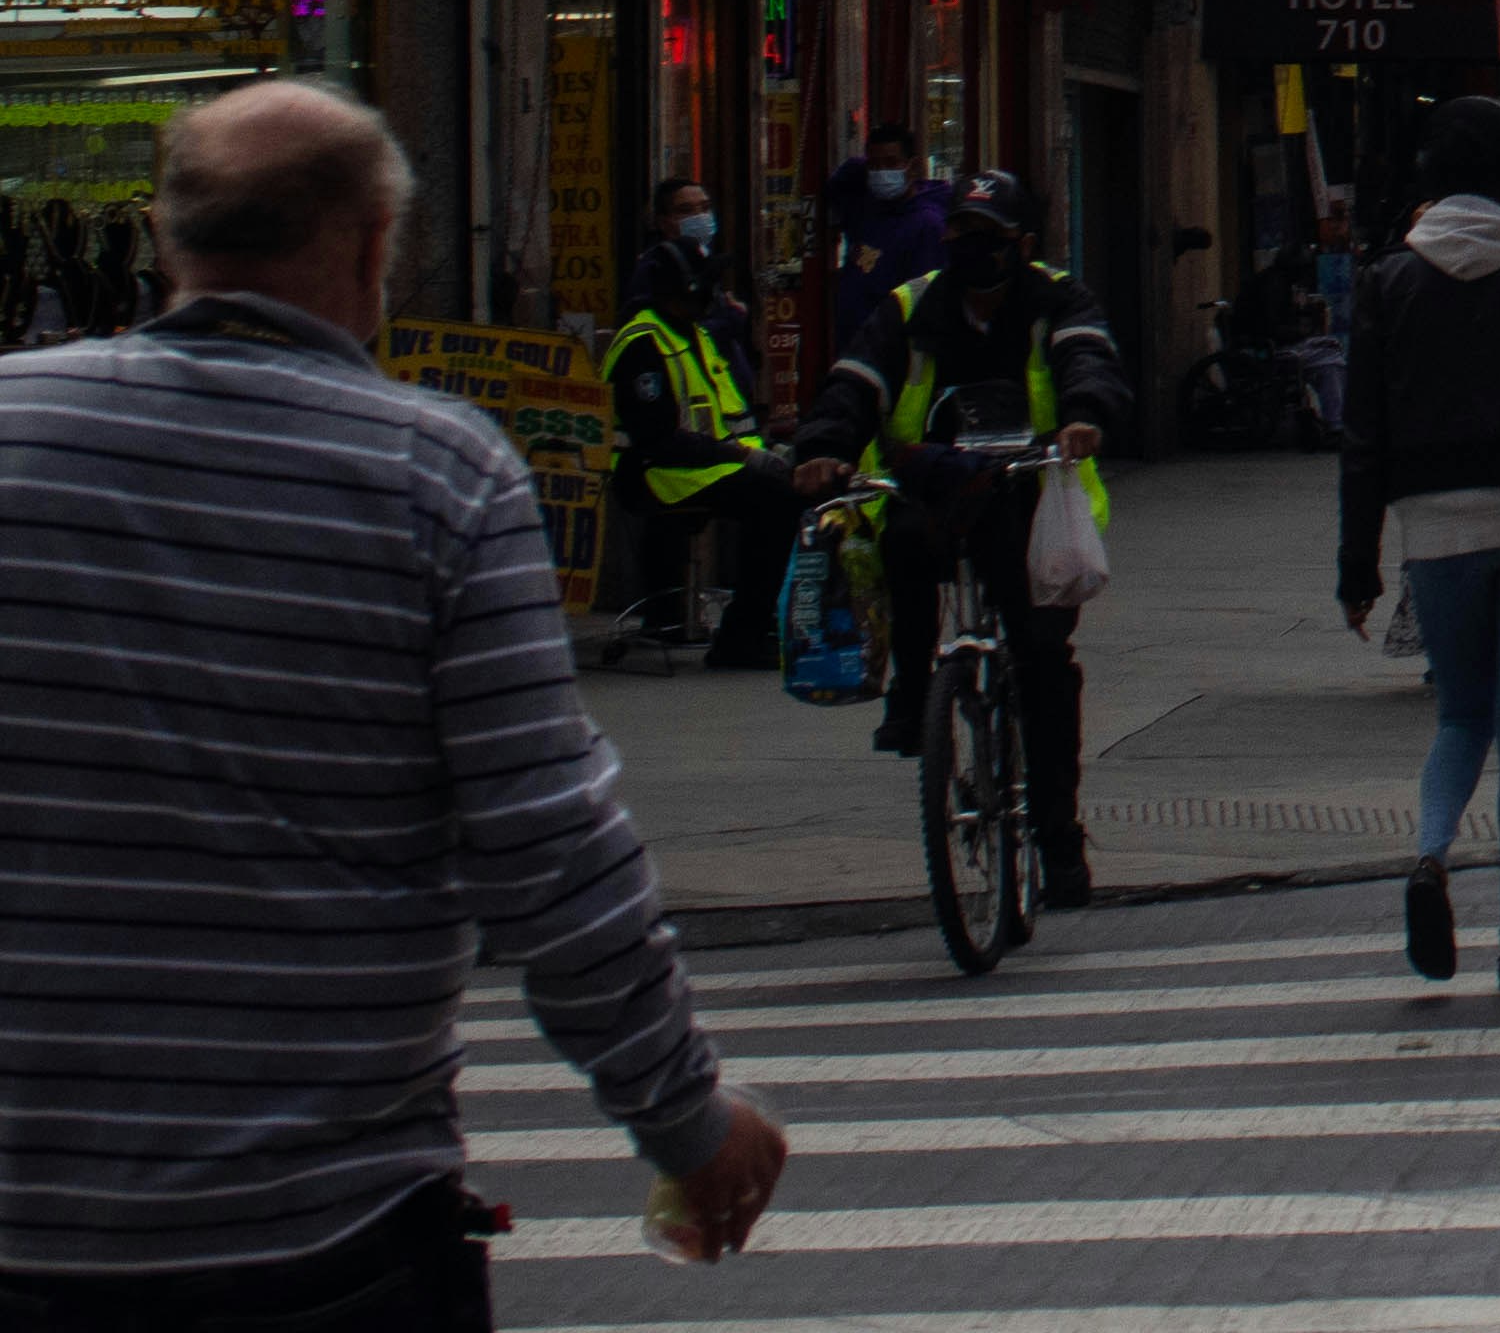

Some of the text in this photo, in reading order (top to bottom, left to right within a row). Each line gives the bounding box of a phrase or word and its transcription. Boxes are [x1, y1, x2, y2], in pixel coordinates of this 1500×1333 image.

[1316, 18, 1387, 52] 710
[389, 326, 436, 358] WE
[441, 333, 500, 357] BUY
[505, 339, 573, 377] GOLD
[419, 366, 508, 400] Silve
